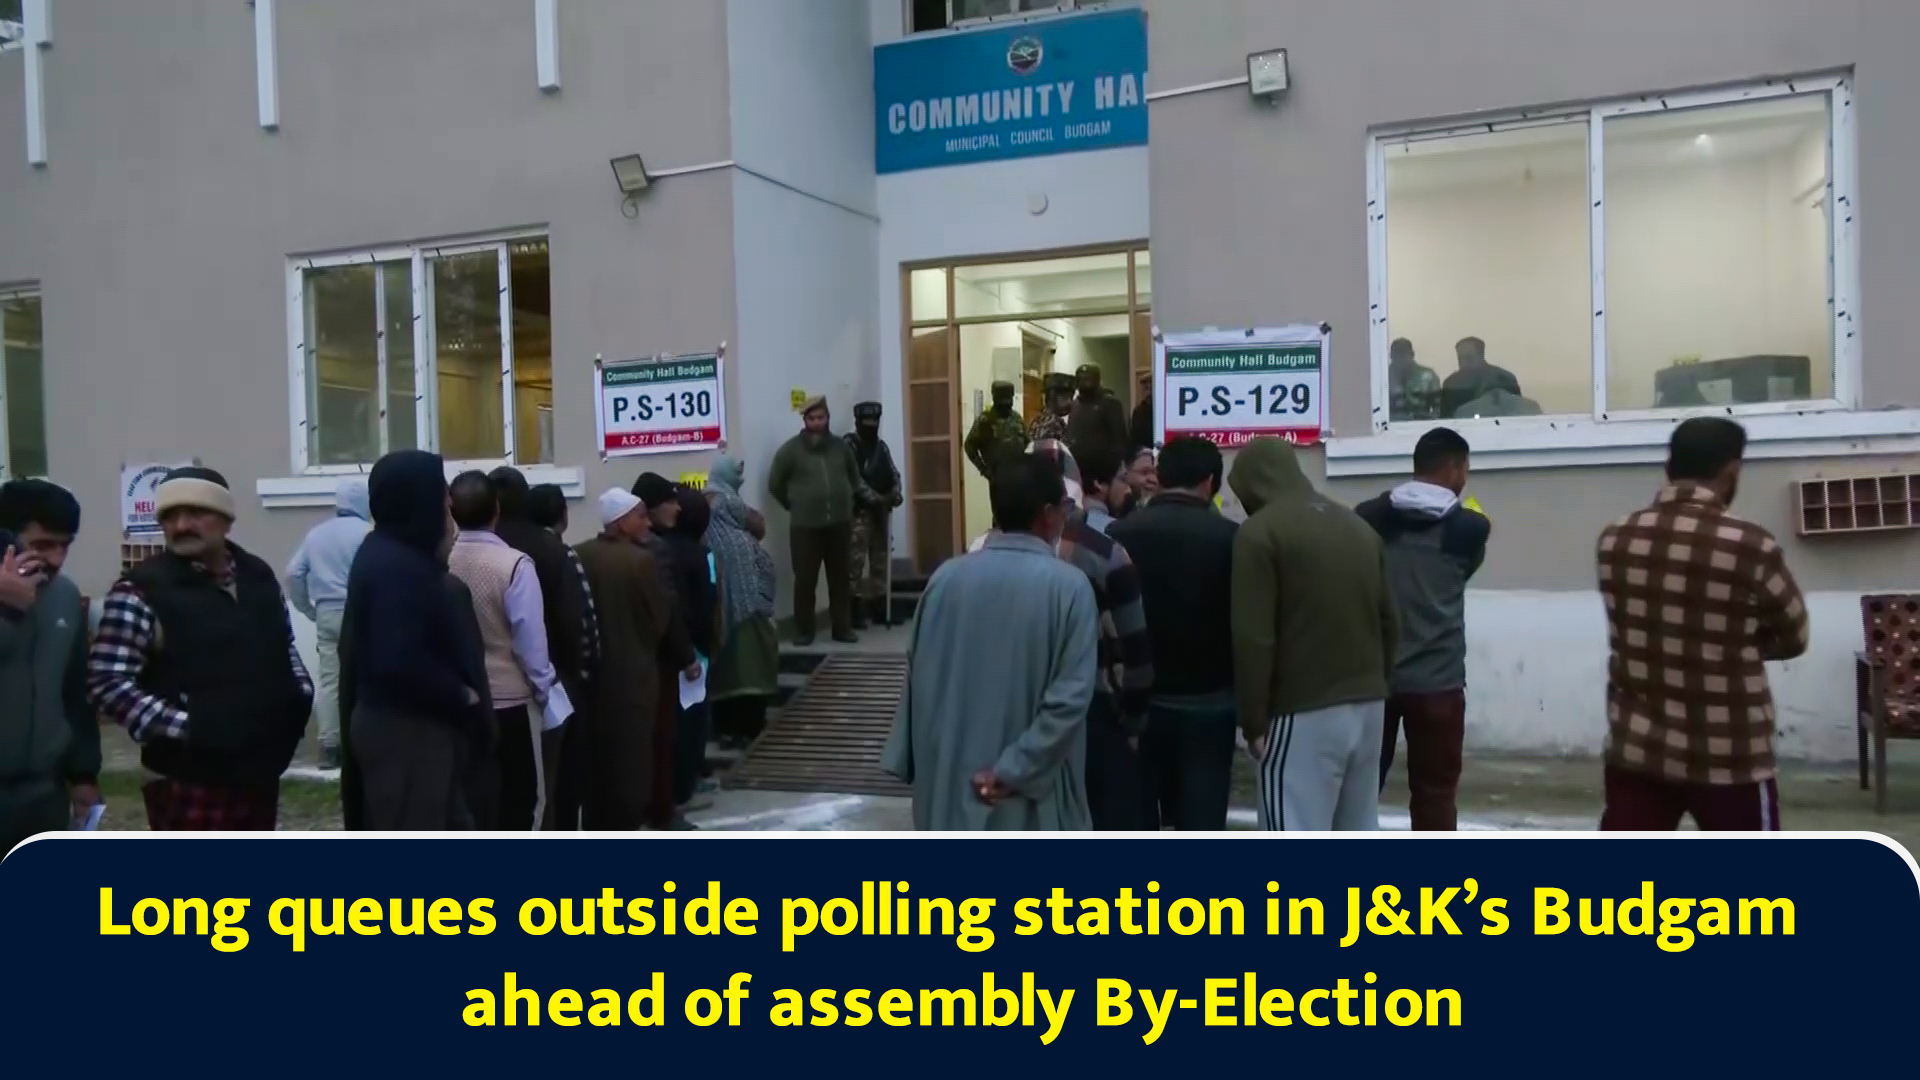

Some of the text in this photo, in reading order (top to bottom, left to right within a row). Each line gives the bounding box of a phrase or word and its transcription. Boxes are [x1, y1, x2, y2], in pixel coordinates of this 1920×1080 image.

[888, 71, 1147, 135] COMMUNITY HA
[945, 120, 1111, 153] MUNICIPAL COUNCIL BUDGAM
[606, 364, 714, 382] Community Hall Budgam
[1171, 353, 1317, 369] Community Hall Budgam
[612, 390, 711, 422] P.S-130
[1178, 383, 1310, 416] P.S-129
